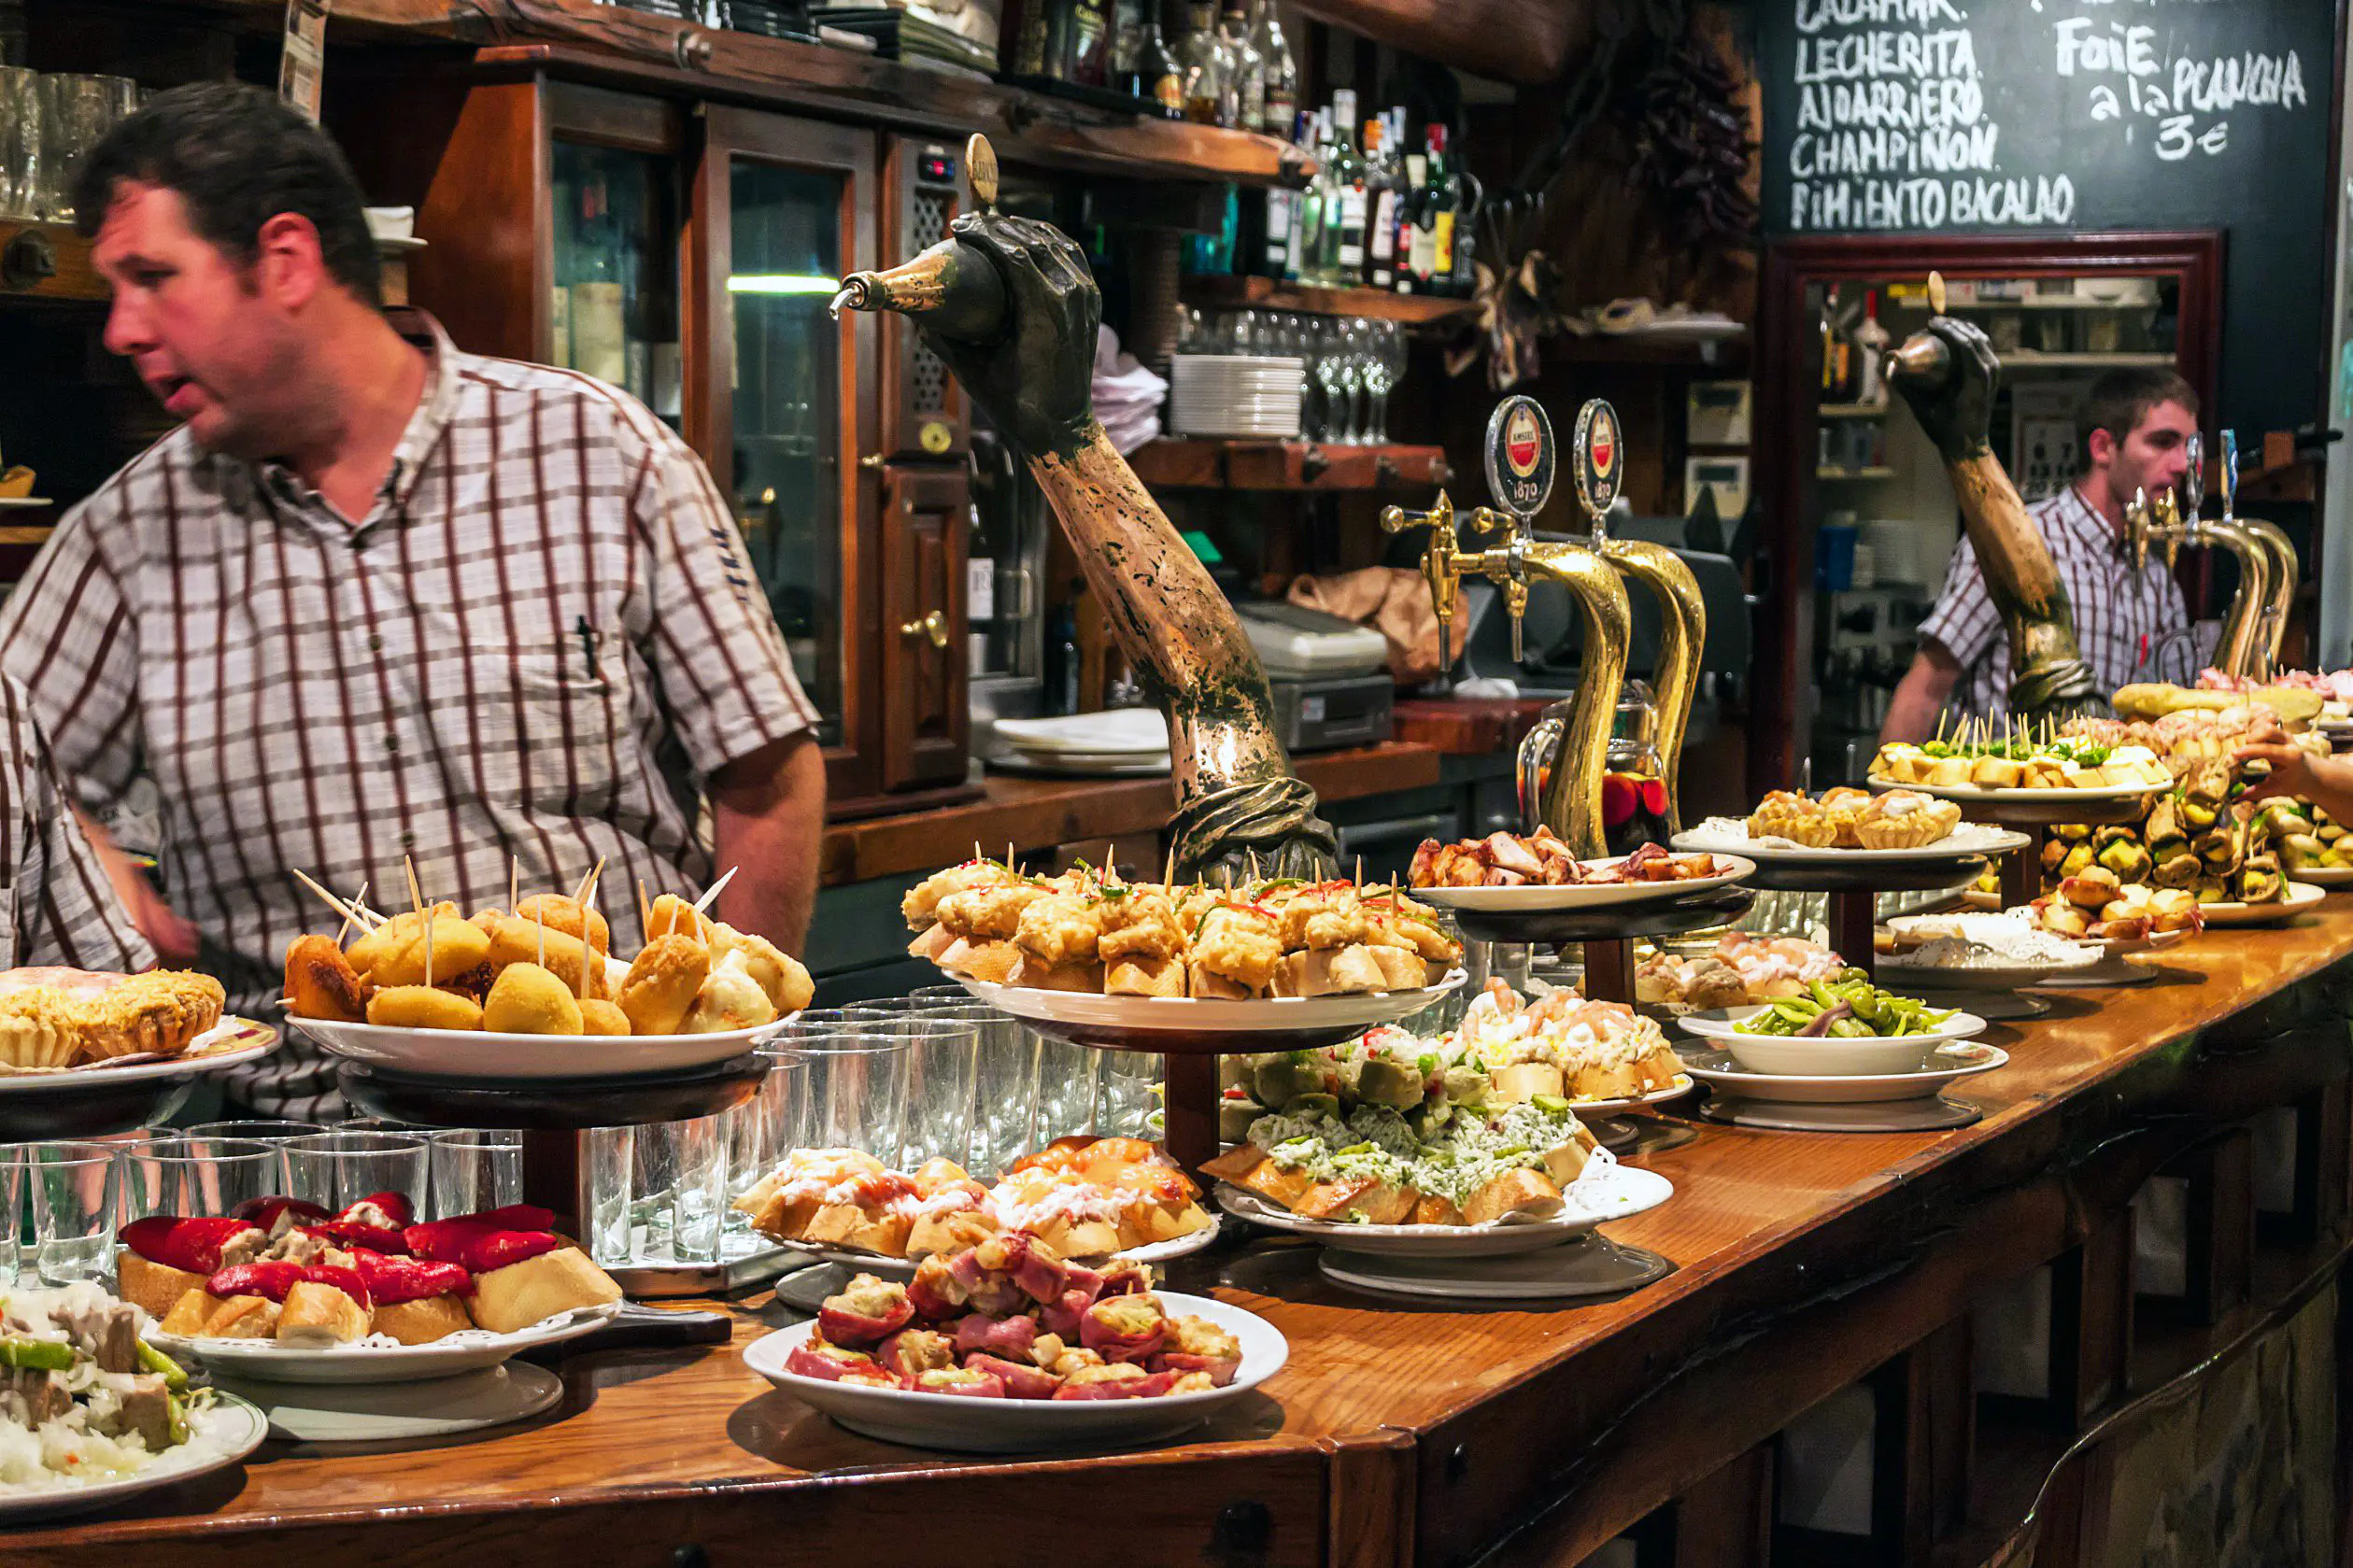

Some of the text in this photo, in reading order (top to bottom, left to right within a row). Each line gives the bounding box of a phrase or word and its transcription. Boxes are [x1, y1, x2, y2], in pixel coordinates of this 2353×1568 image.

[2090, 85, 2121, 121] a
[1950, 173, 2076, 224] BACALAO
[1514, 481, 1538, 501] 1870
